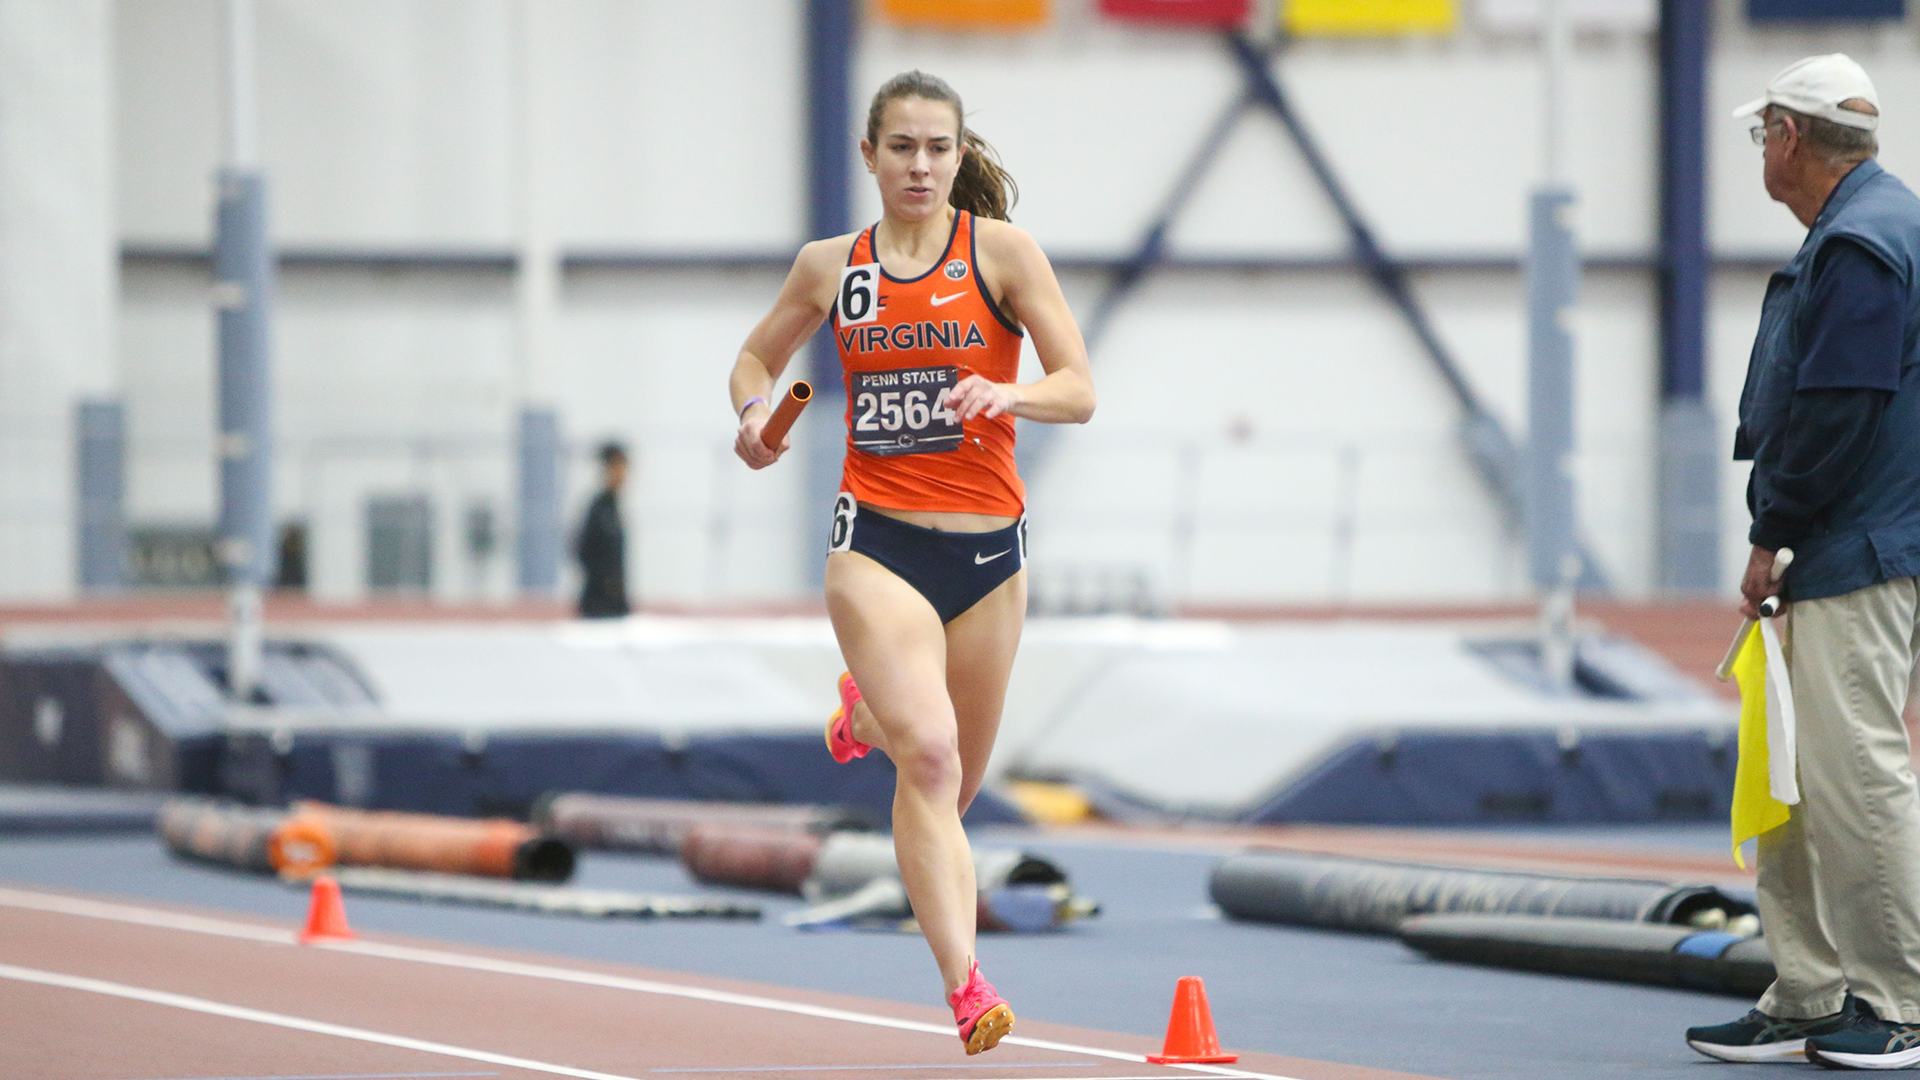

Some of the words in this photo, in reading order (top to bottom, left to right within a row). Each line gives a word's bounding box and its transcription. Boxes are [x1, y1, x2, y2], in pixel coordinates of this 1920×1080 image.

[842, 269, 871, 321] 6
[838, 320, 987, 353] VIRGINIA
[862, 373, 899, 387] PENN
[902, 369, 947, 385] STATE
[856, 387, 955, 431] 2564
[832, 497, 850, 549] 6
